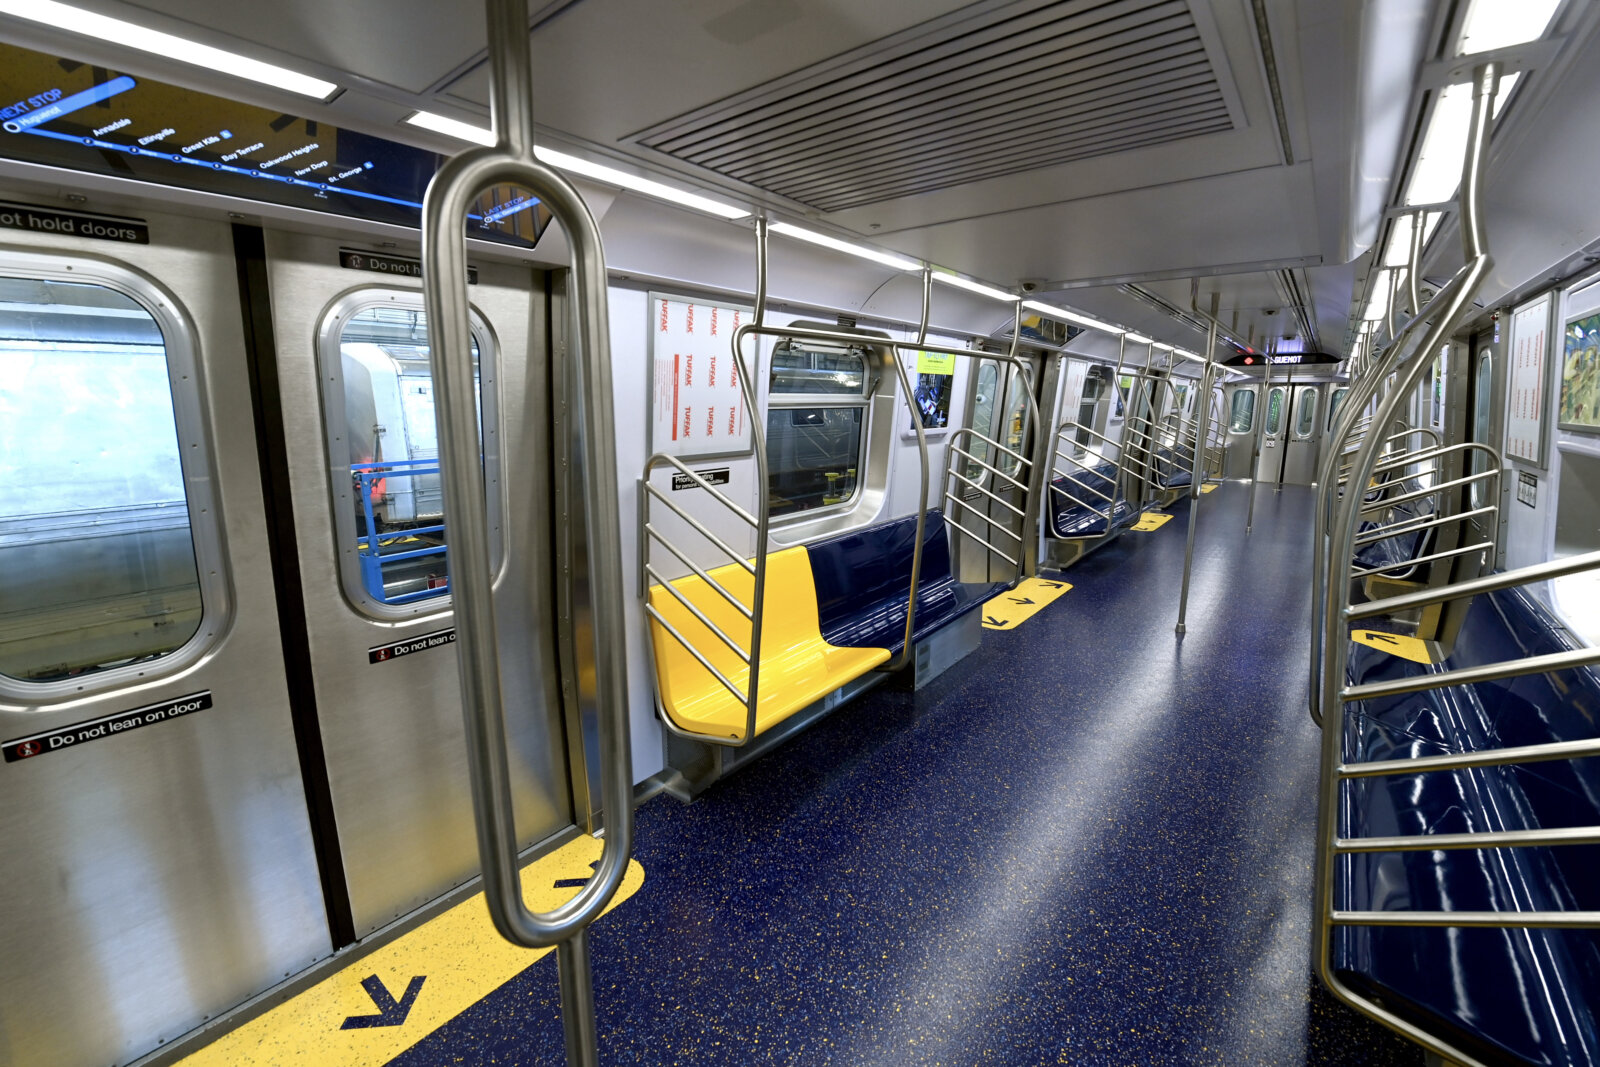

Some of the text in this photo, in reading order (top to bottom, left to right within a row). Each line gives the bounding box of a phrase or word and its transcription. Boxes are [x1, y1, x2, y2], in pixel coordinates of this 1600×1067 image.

[0, 88, 63, 121] NEXT STOP
[93, 118, 132, 137] Annadale
[181, 136, 220, 154] Great Kills
[221, 142, 264, 162] Bay Terrace
[259, 143, 319, 169] Oakwood Heights
[294, 160, 329, 176] New Dorp
[338, 166, 363, 179] George
[503, 196, 524, 208] STOP
[0, 212, 137, 240] ot hold doors
[369, 258, 387, 271] Do
[391, 262, 411, 274] not
[1265, 355, 1302, 364] GUENOT
[683, 406, 691, 438] TUFFAK
[394, 633, 456, 656] Do not lean o
[49, 700, 203, 749] Do not lean on door
